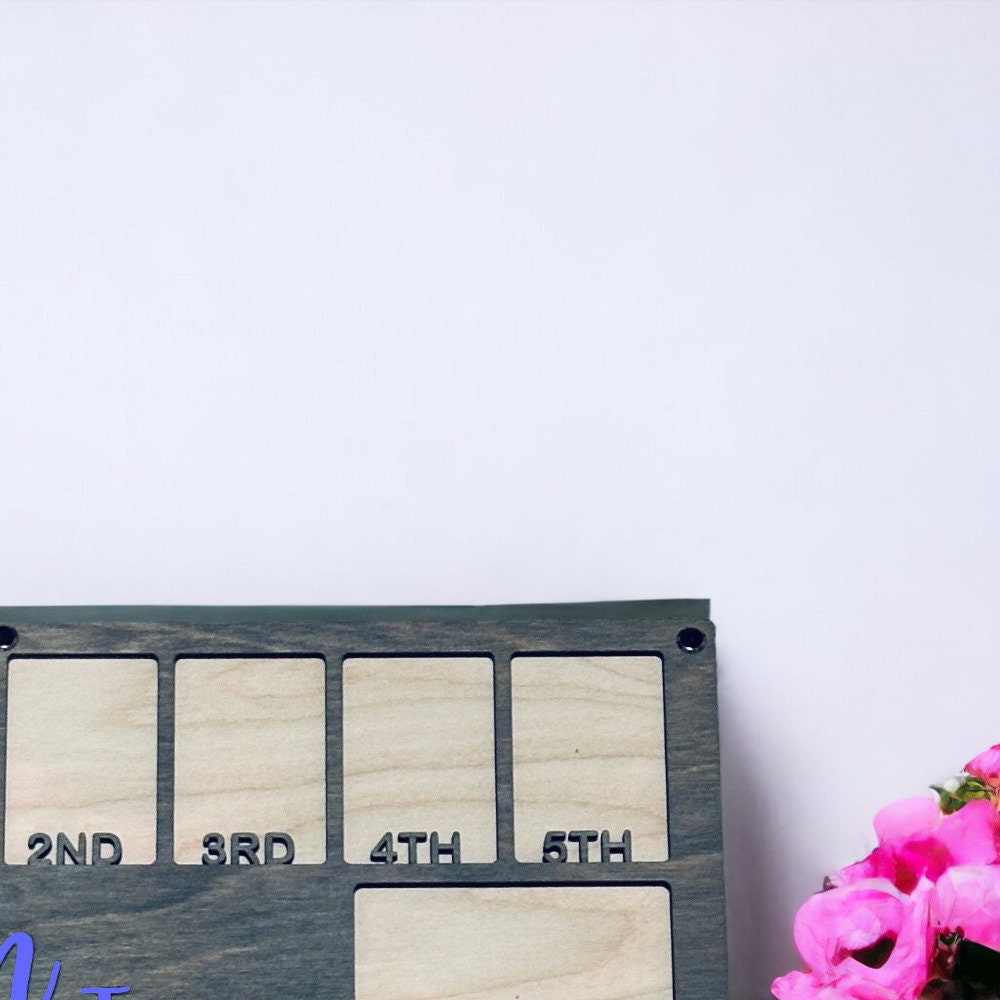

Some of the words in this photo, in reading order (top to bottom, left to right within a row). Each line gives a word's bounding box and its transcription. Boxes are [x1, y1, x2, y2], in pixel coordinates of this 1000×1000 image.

[26, 831, 123, 866] 2ND
[201, 831, 296, 866] 3RD
[369, 830, 461, 865] 4TH
[541, 829, 633, 864] 5TH
